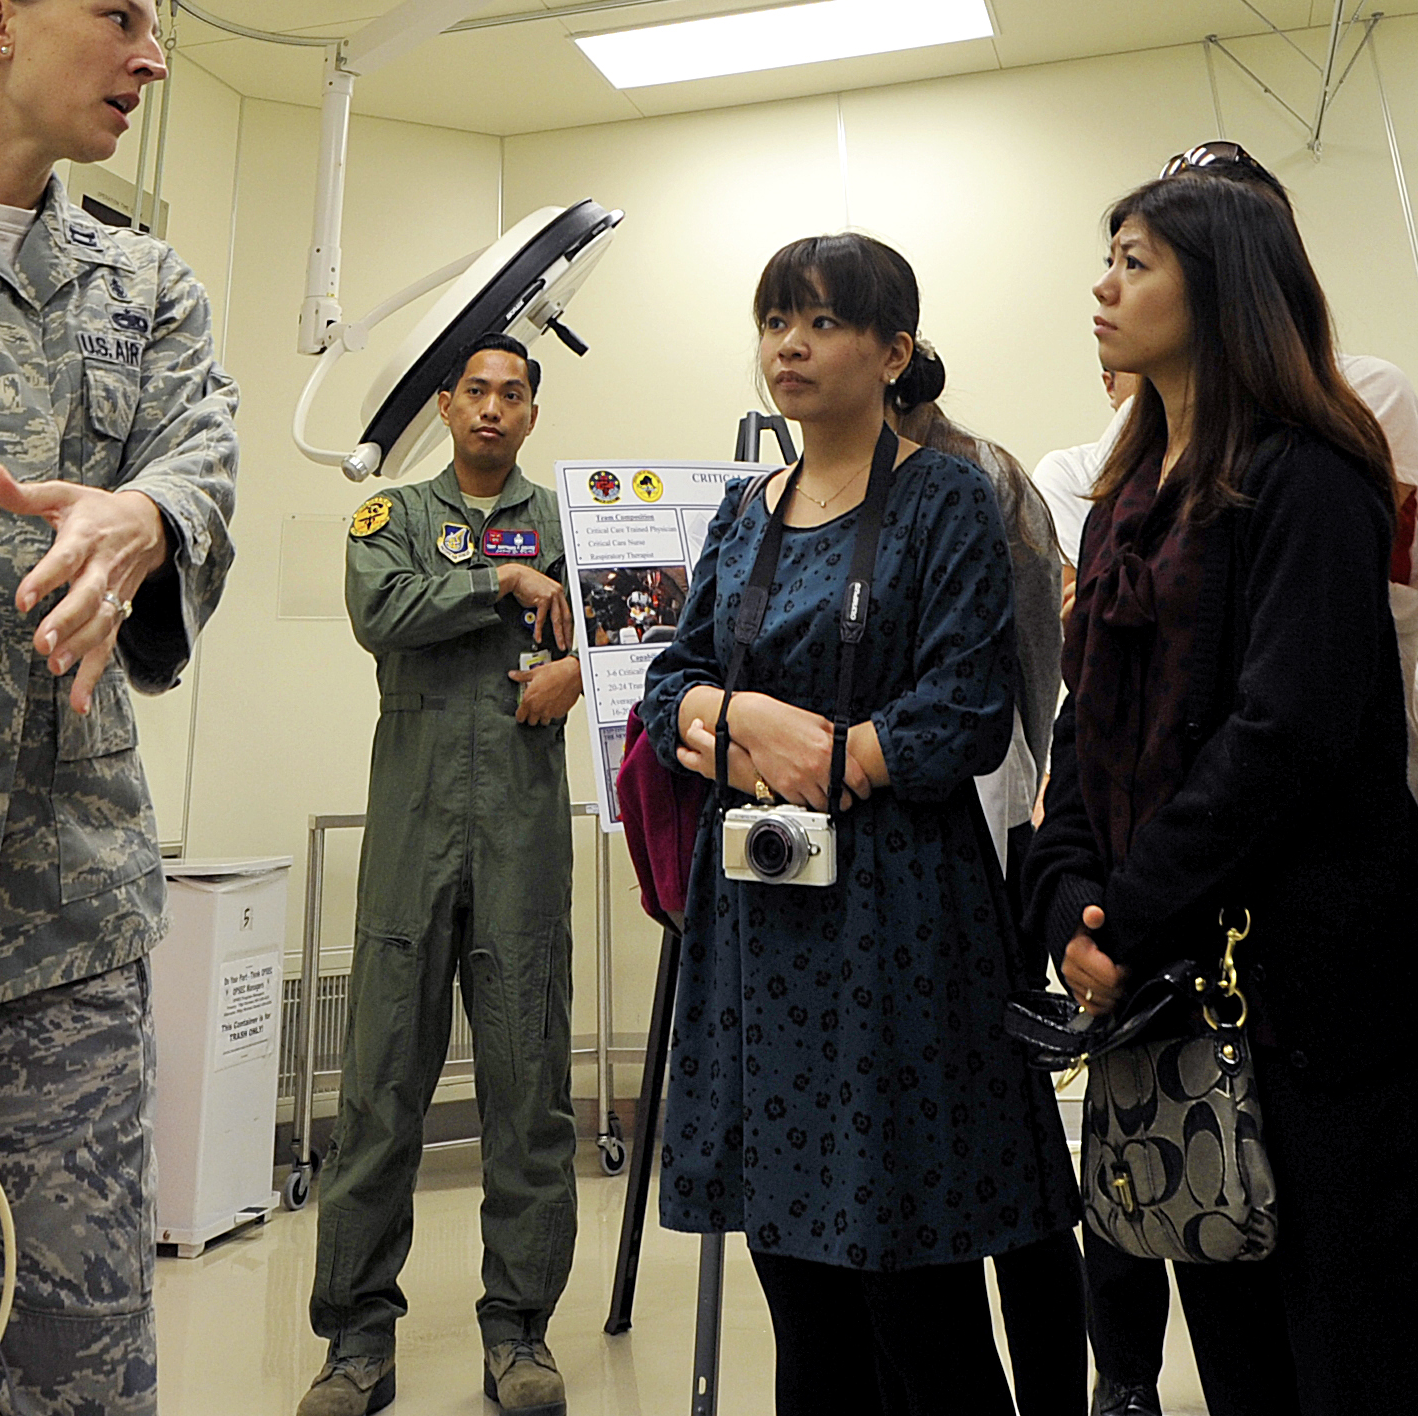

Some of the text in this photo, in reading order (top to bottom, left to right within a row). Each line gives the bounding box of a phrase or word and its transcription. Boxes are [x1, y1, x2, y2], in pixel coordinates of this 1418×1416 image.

[81, 334, 141, 366] U.S. AIR
[596, 514, 613, 522] Team
[610, 526, 624, 534] Care
[649, 525, 677, 533] Physician
[612, 539, 628, 547] Care
[590, 552, 654, 561] Respiratory Therapist
[850, 583, 861, 621] OLYMPUS
[606, 669, 617, 677] 3-6
[608, 683, 626, 692] 20-24
[233, 1016, 259, 1030] Container
[229, 1030, 247, 1042] TRASH
